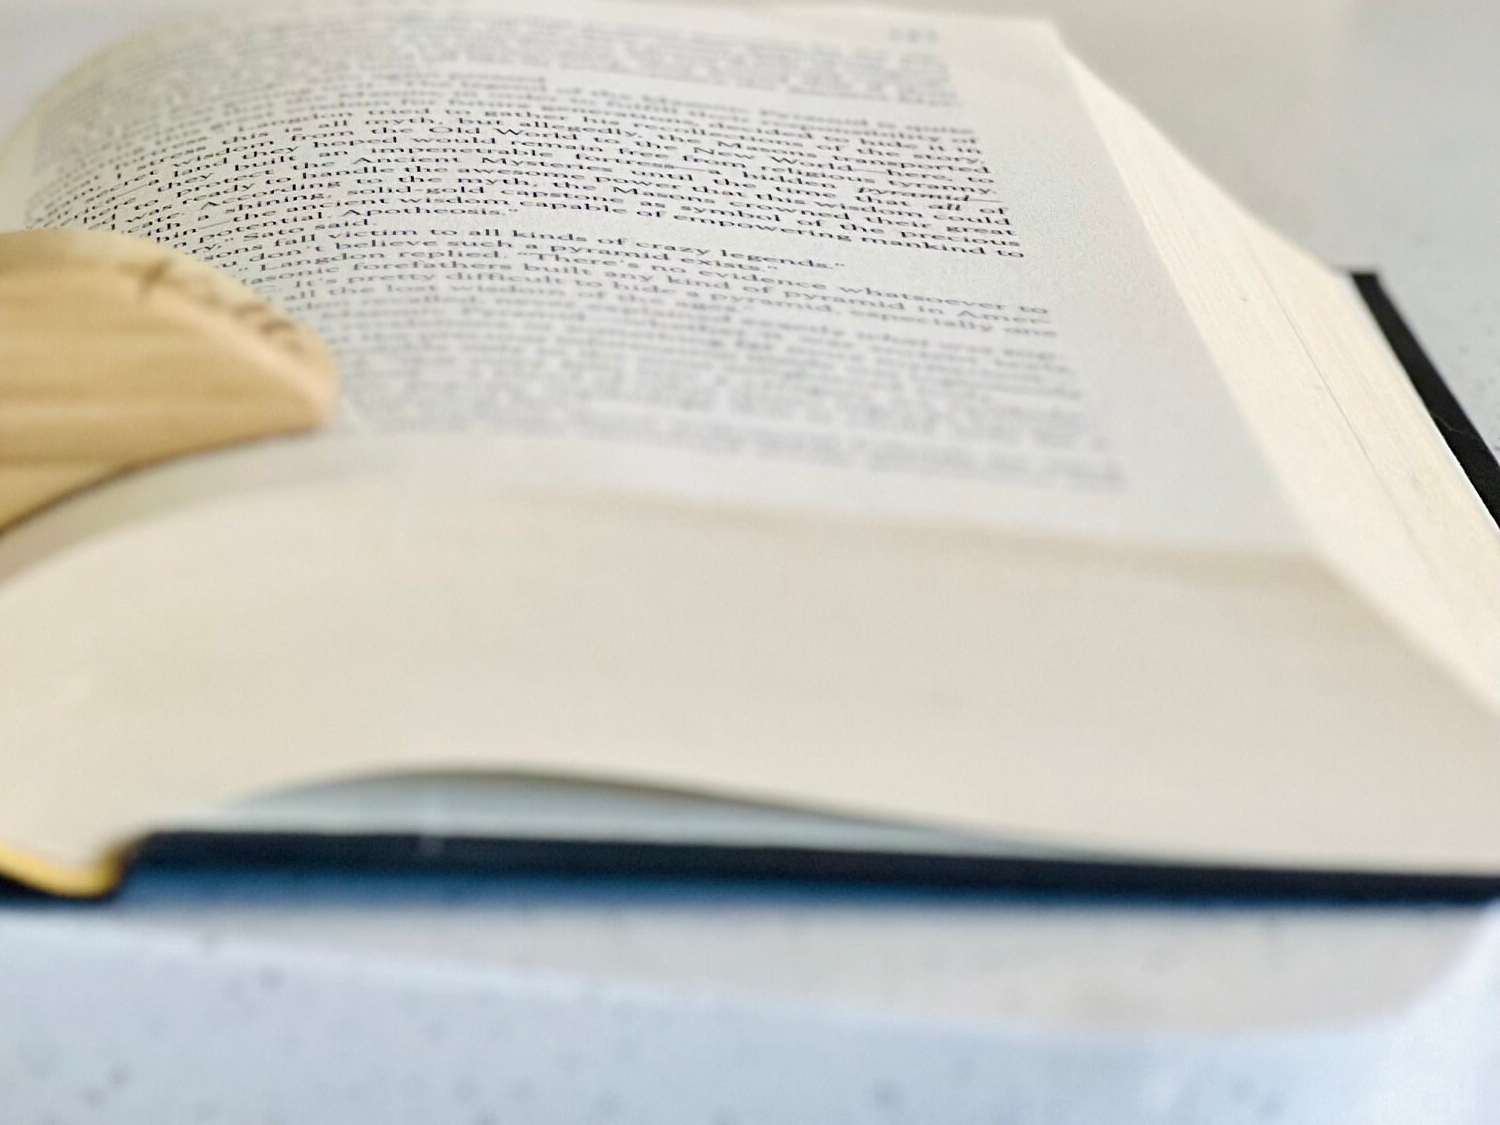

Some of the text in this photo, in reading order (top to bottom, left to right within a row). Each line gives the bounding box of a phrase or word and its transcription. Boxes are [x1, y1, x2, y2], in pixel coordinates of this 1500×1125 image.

[84, 166, 161, 203] secret
[171, 140, 274, 168] wisdom
[289, 129, 354, 142] from
[370, 125, 413, 133] the
[428, 125, 481, 134] Old
[493, 126, 579, 140] World
[593, 135, 621, 144] to
[633, 139, 678, 150] the
[693, 145, 756, 159] New
[965, 175, 995, 184] to
[124, 164, 1011, 227] was ready to handle the awesome power that this wisdom could
[133, 155, 1008, 216] to protect the Ancient Mysteries until the time that all of
[156, 170, 216, 193] they
[232, 153, 296, 171] built
[318, 149, 349, 157] an
[369, 145, 553, 157] impenetrable
[742, 170, 837, 189] hidden
[199, 174, 1019, 237] According to the myth, the Masons crowned their great
[223, 193, 333, 214] shining,
[345, 184, 485, 195] solid-gold
[499, 189, 625, 204] capstone
[638, 200, 666, 208] as
[678, 204, 781, 222] symbol
[795, 218, 826, 227] of
[838, 222, 885, 234] the
[899, 230, 1023, 247] precious
[242, 218, 377, 241] Sato said.
[285, 196, 1026, 259] ancient wisdom capable of empowering mankind to
[273, 233, 316, 247] fall
[325, 228, 418, 239] victim
[467, 228, 499, 236] all
[511, 229, 589, 242] kinds
[596, 237, 629, 246] of
[634, 241, 709, 256] crazy
[719, 248, 843, 269] legends.”
